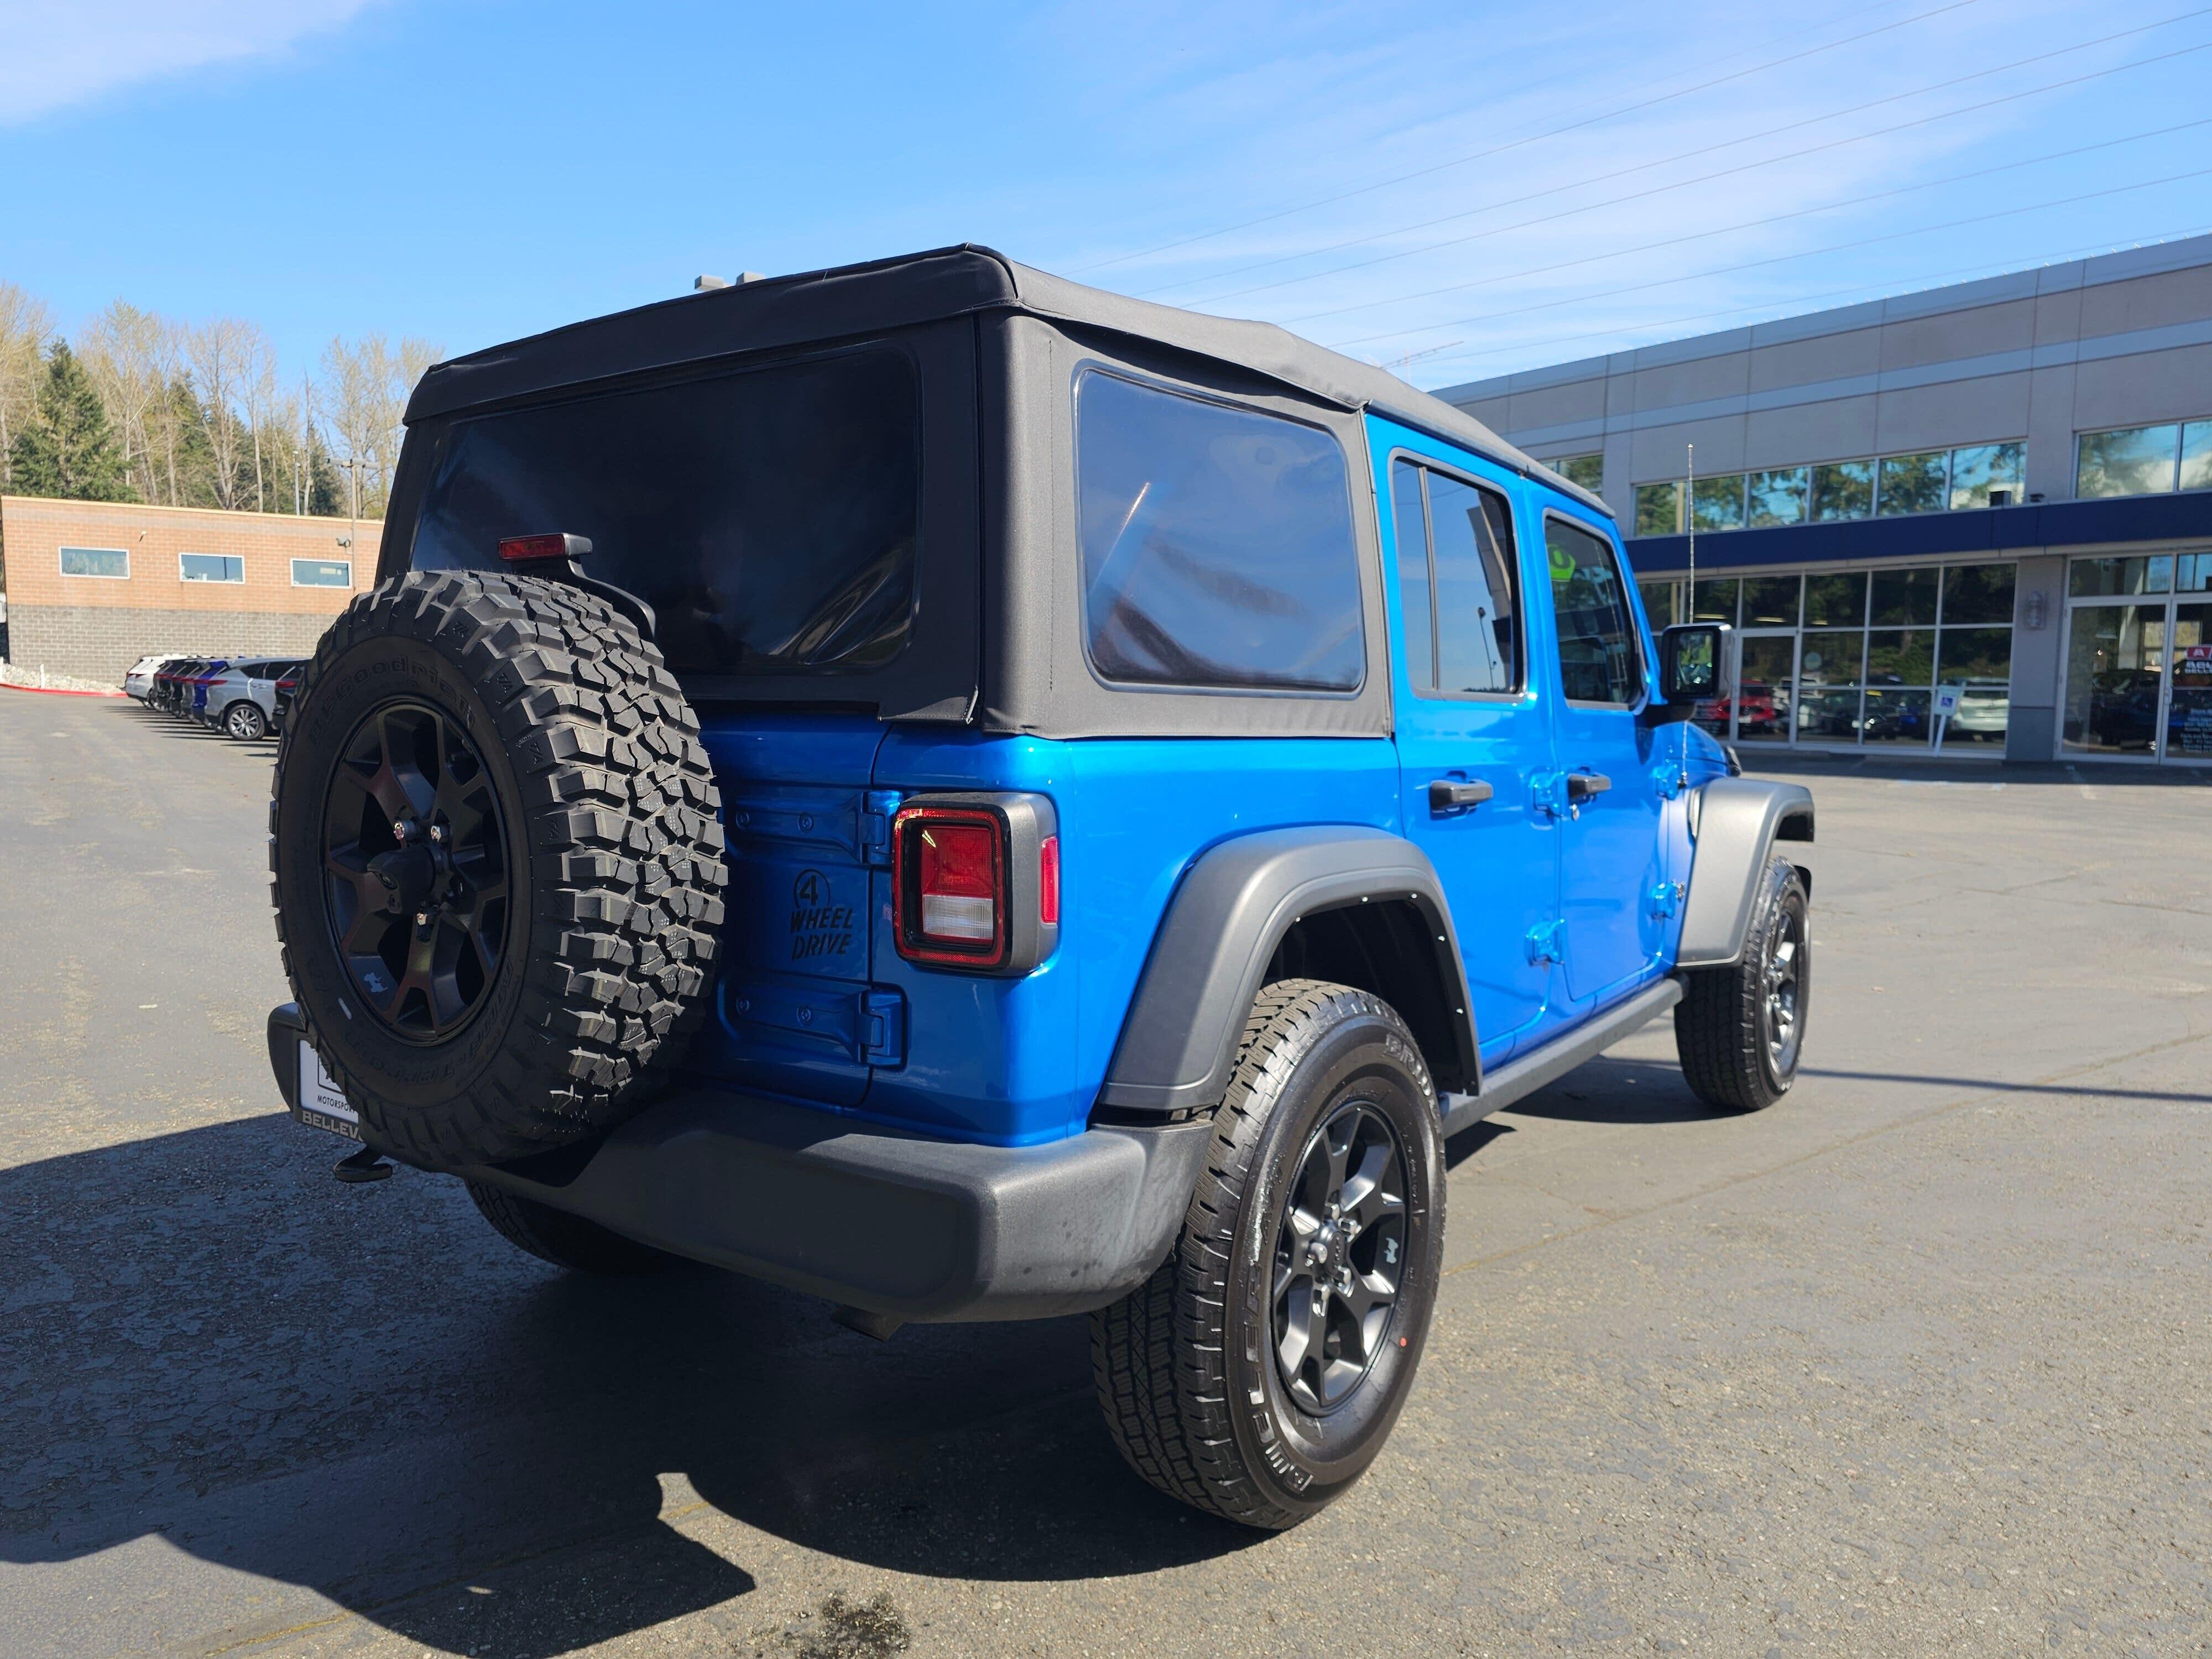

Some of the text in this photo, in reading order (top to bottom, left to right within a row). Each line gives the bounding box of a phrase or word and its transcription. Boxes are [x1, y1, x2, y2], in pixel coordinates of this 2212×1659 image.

[799, 874, 819, 906] 4
[790, 907, 854, 934] WHEEL
[791, 932, 852, 961] DRIVE
[302, 1110, 363, 1142] BELLEV
[1244, 1263, 1314, 1493] DUELER
